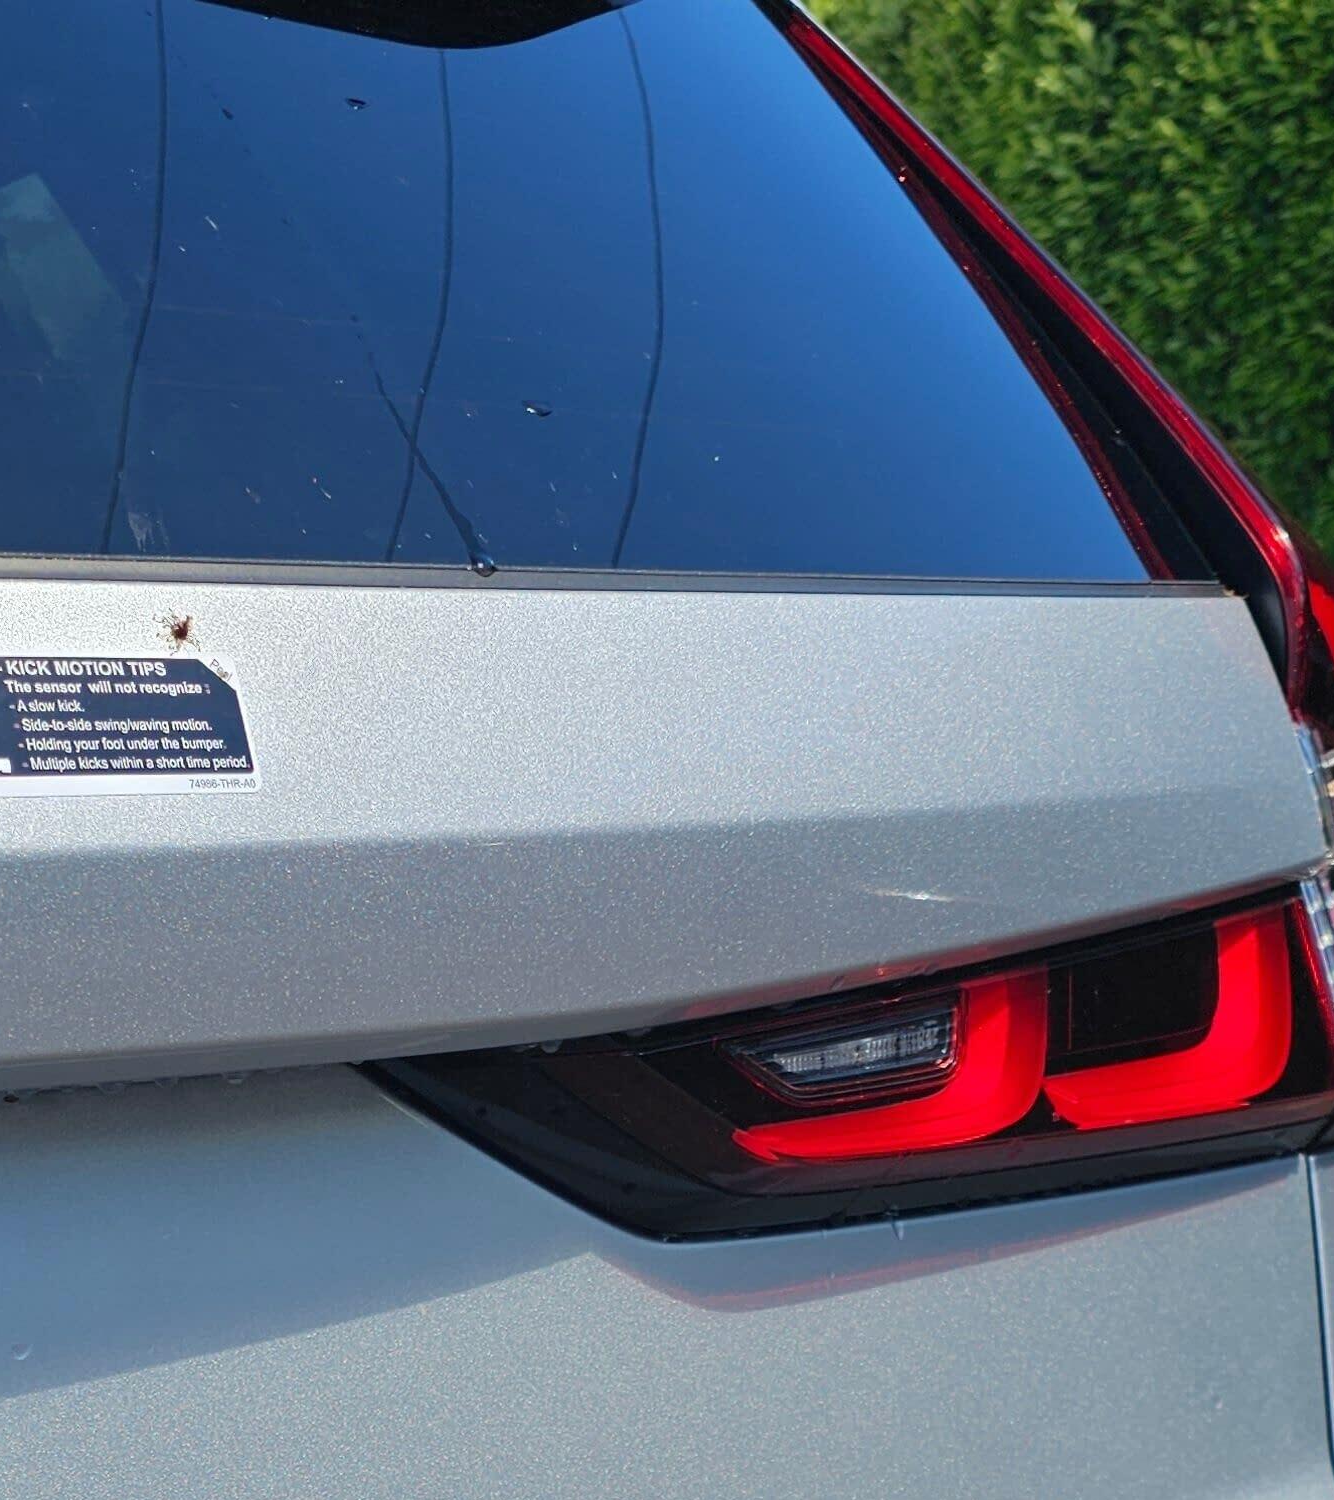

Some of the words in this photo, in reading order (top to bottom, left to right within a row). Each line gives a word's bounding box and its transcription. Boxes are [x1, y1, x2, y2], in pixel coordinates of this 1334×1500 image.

[5, 660, 51, 676] KICK
[53, 661, 125, 676] MOTION
[126, 662, 166, 676] TIPS
[209, 659, 234, 681] Peel
[3, 680, 32, 693] The
[34, 682, 82, 694] sensor
[87, 681, 112, 694] will
[114, 681, 138, 694] not
[139, 681, 203, 696] recognize
[17, 700, 27, 712] A
[28, 700, 56, 712] slow
[57, 699, 85, 712] kick.
[21, 718, 93, 732] Side-to-side
[95, 718, 170, 733] swing/waving
[171, 719, 213, 731] motion.
[25, 738, 71, 753] Holding
[73, 740, 100, 752] your
[101, 737, 125, 750] foot
[127, 738, 160, 750] under
[161, 738, 179, 750] the
[30, 757, 76, 772] Multiple
[78, 757, 109, 770] kicks
[110, 757, 145, 769] within
[146, 759, 154, 769] a
[156, 756, 184, 769] short
[186, 756, 211, 769] time
